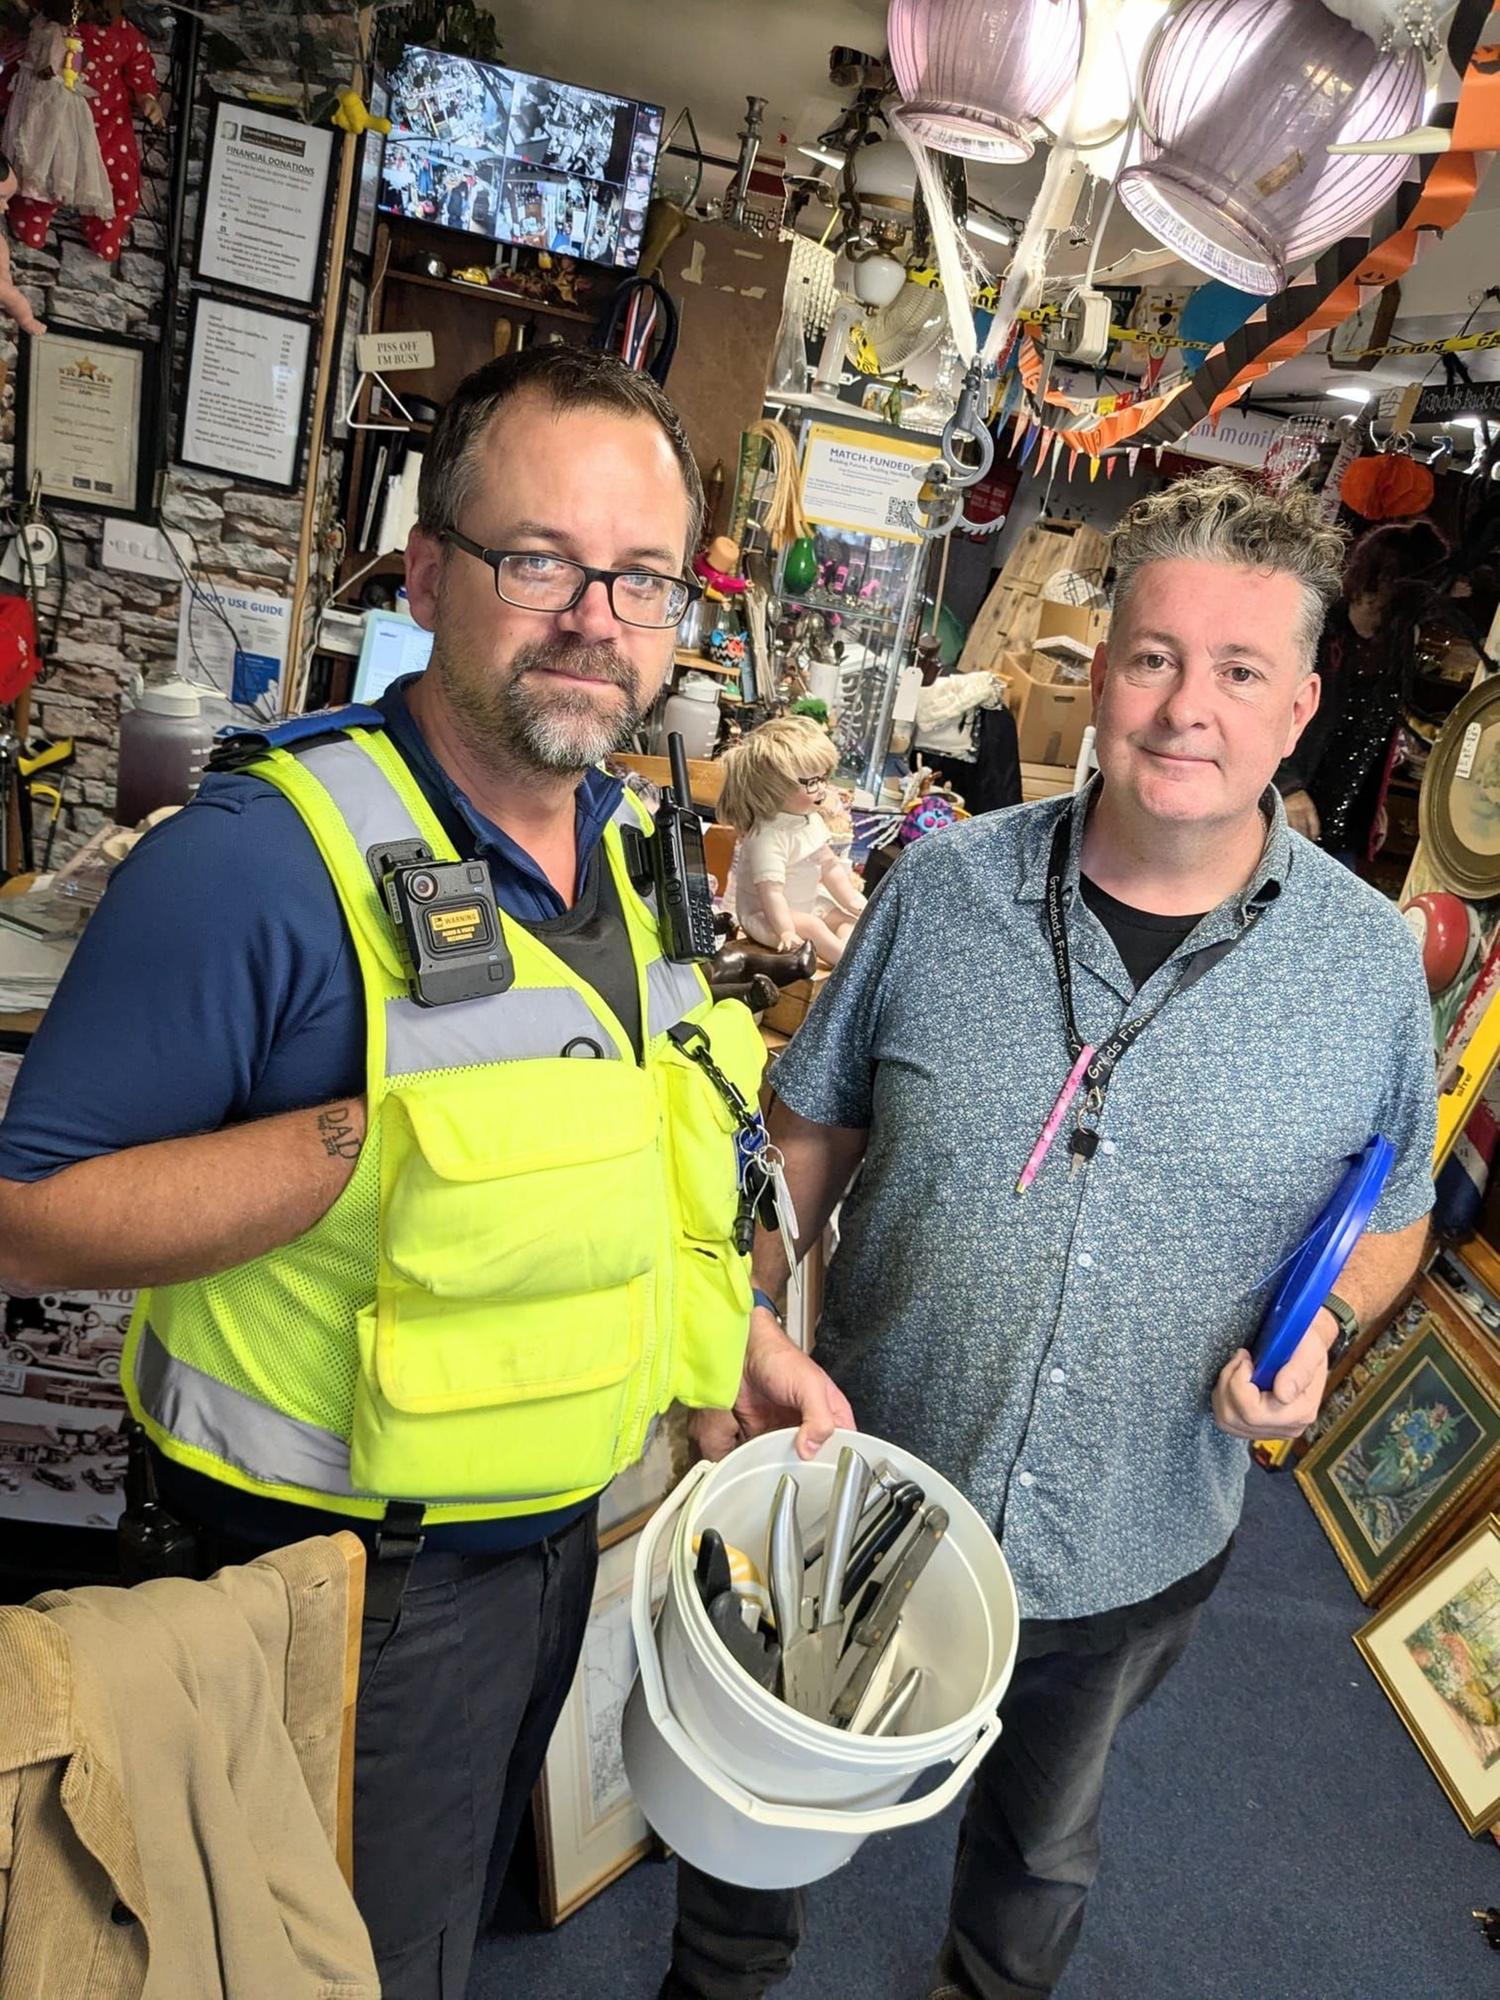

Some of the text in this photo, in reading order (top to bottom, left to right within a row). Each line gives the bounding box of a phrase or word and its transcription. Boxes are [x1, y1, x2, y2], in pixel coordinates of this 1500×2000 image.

[226, 146, 266, 163] FINANCIAL
[268, 157, 315, 174] DONATIONS
[377, 341, 417, 353] PISS OFF
[377, 353, 420, 365] I'M BUSY
[228, 597, 249, 610] USE
[250, 602, 284, 617] GUIDE
[445, 911, 476, 925] WARNING
[1049, 875, 1062, 938] Grandads
[1055, 941, 1067, 980] Front
[325, 1107, 361, 1159] DAD
